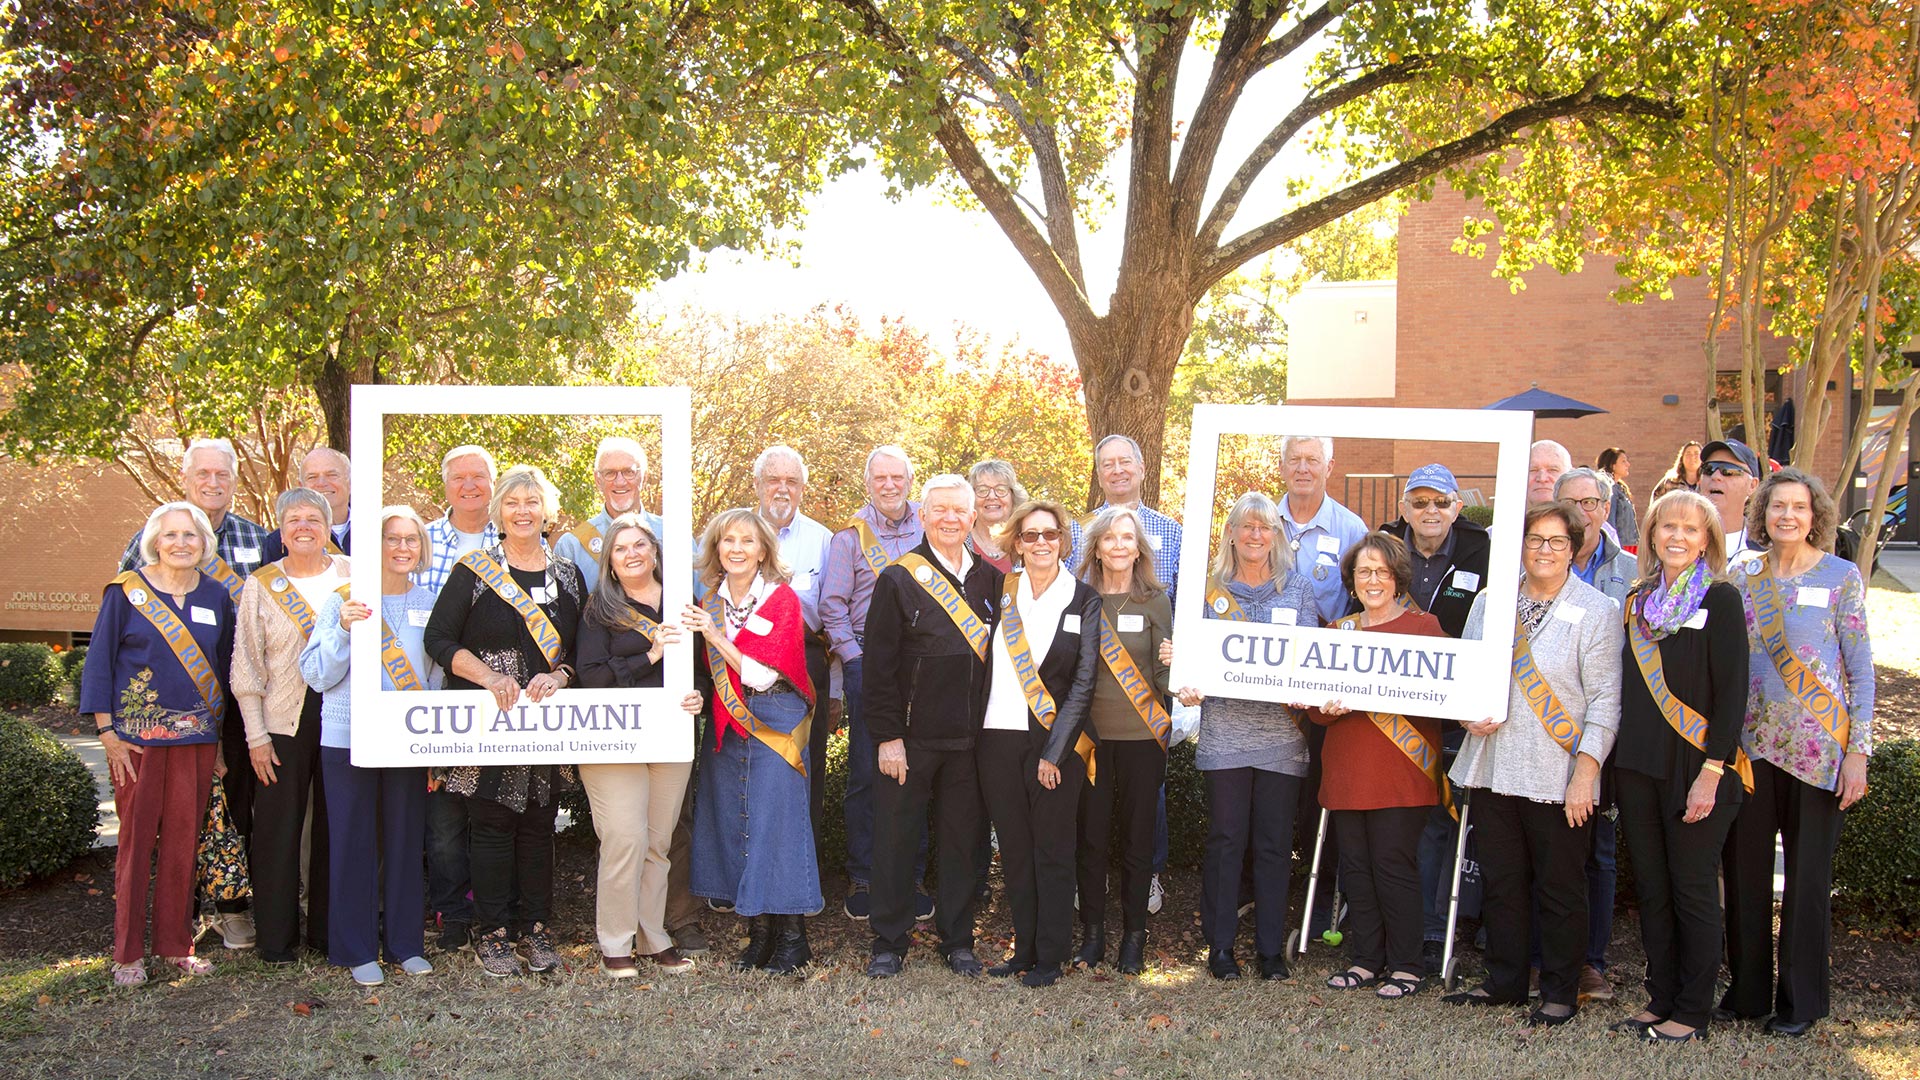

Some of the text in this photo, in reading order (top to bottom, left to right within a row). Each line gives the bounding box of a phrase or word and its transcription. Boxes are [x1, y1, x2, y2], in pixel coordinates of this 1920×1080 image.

[865, 545, 887, 574] 50
[5, 601, 100, 613] ENTREPRENEURSHIP CENTER
[11, 592, 37, 602] JOHN
[49, 592, 77, 602] COOK
[464, 551, 561, 663] 50th REUNIO
[924, 571, 960, 614] 50th
[141, 599, 183, 643] 50th
[180, 645, 225, 721] REUNIO
[1221, 634, 1457, 681] CIU ALUMNI
[1751, 578, 1848, 733] 50th REUNION
[1013, 651, 1053, 726] REUNIO
[1117, 666, 1170, 742] REUNIO
[1223, 671, 1448, 706] Columbia International University
[1513, 653, 1580, 755] REUNION
[1648, 667, 1709, 747] REUNIO
[404, 703, 642, 735] CIU ALUMNI
[1373, 712, 1437, 770] UNION
[409, 739, 638, 754] Columbia International University
